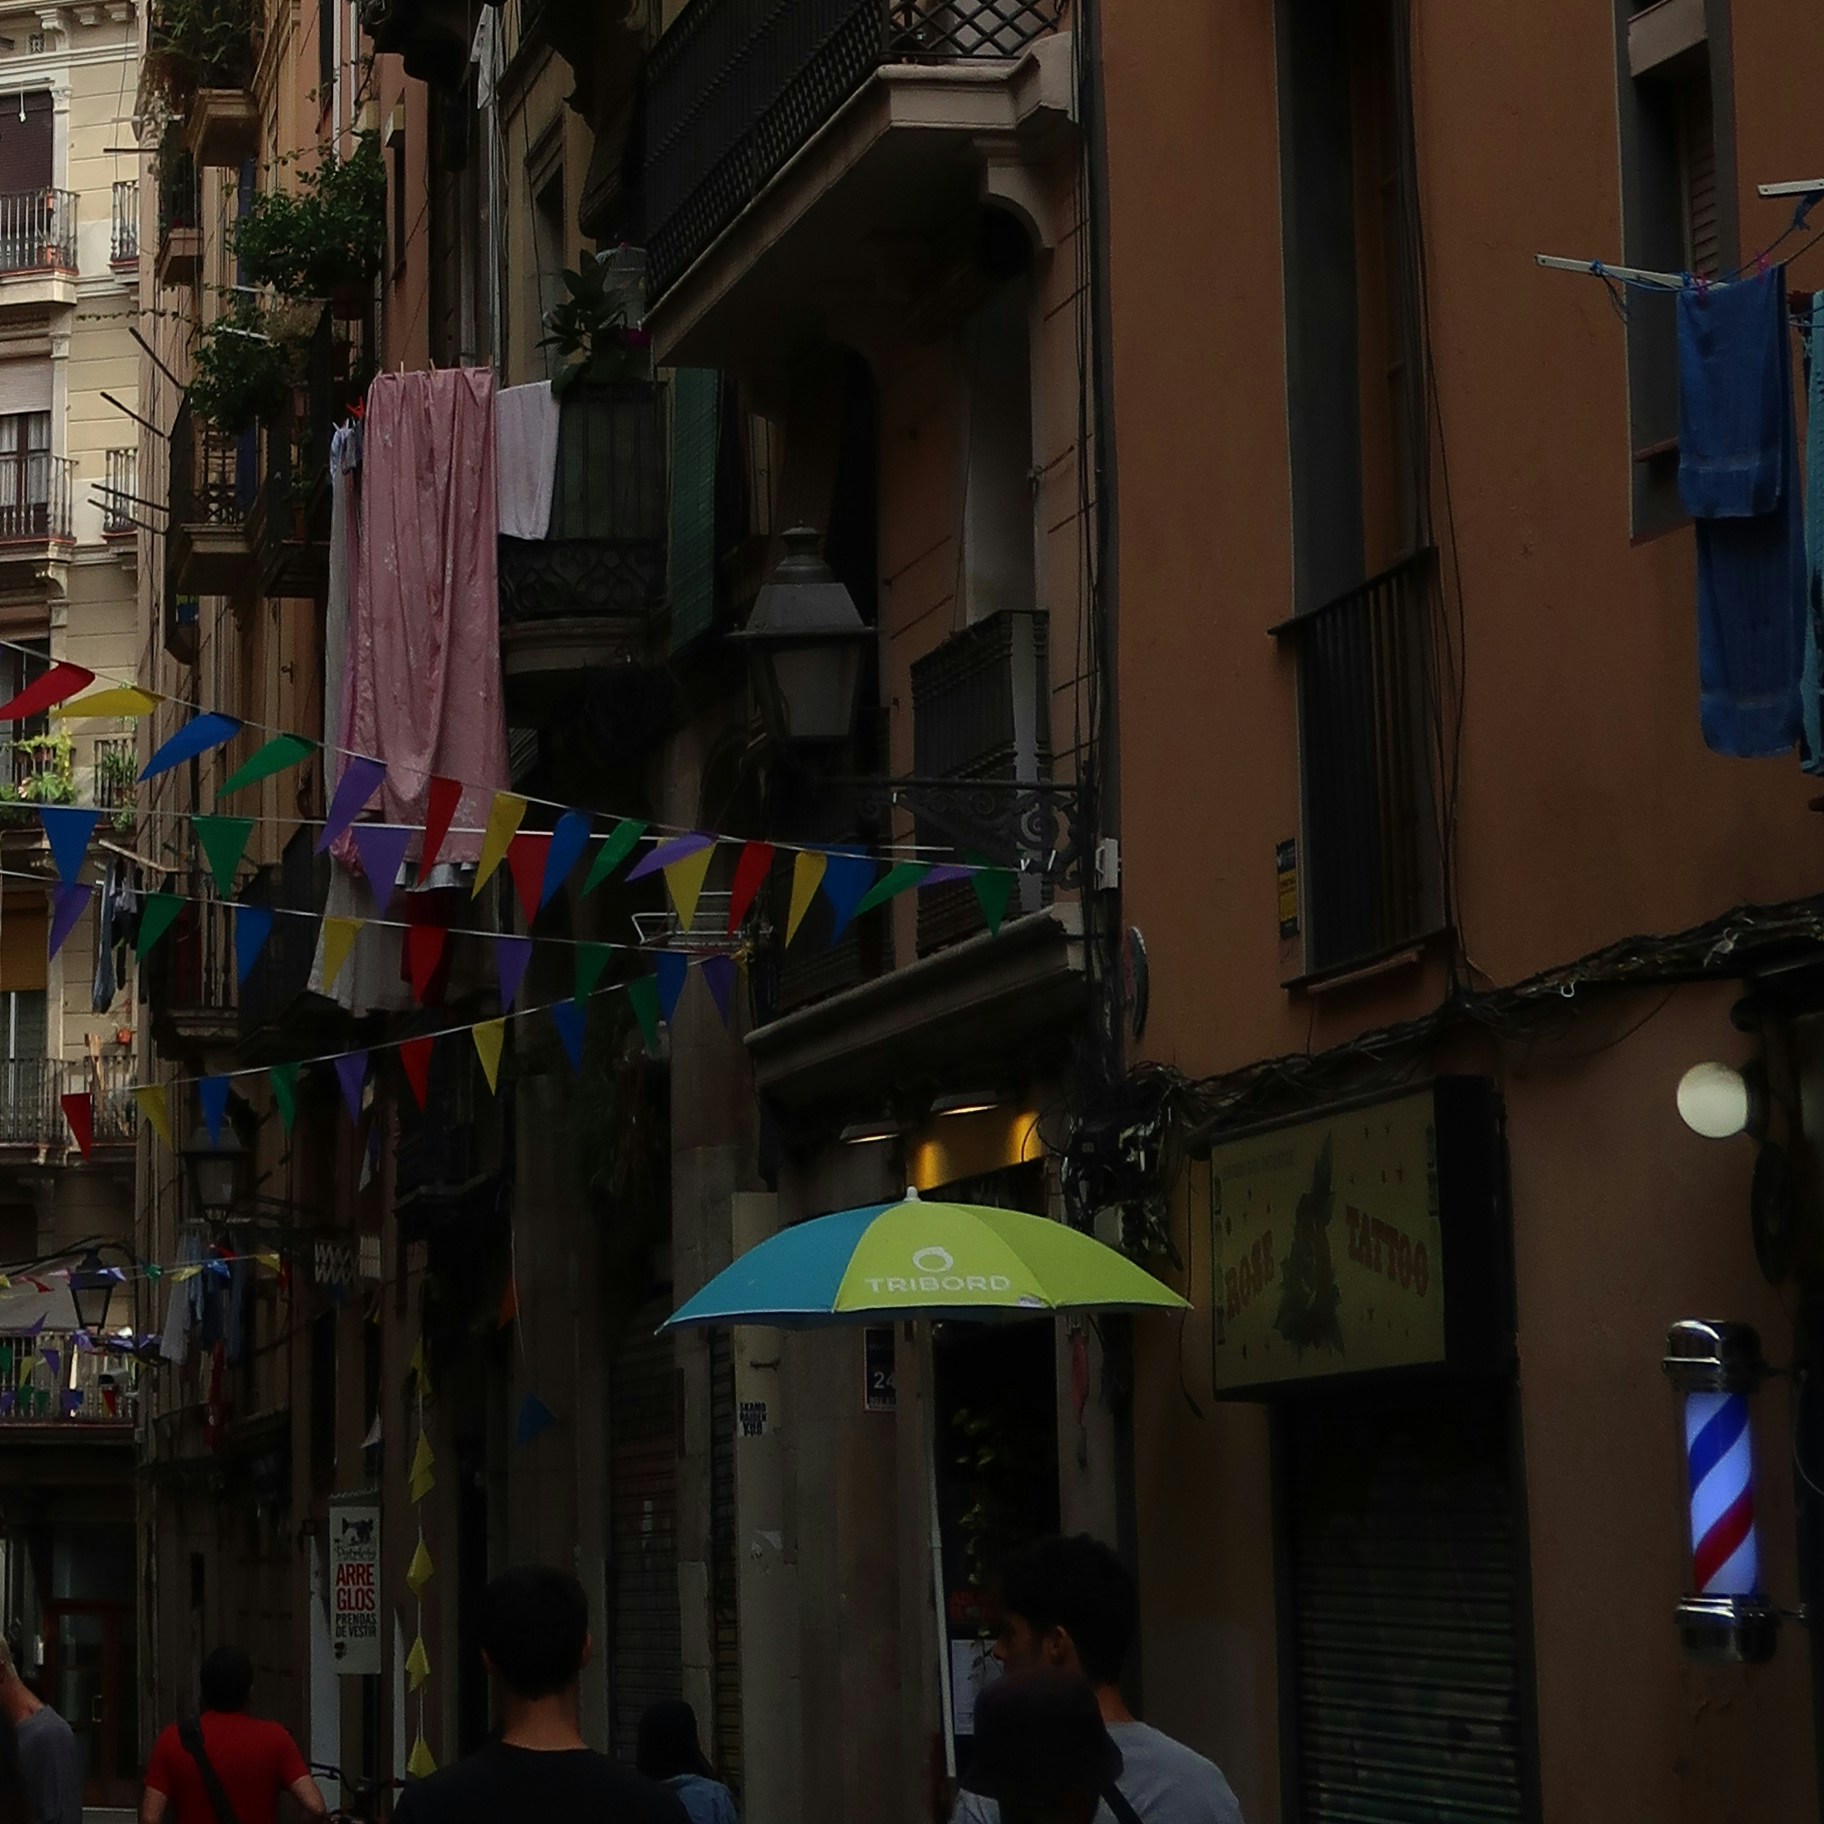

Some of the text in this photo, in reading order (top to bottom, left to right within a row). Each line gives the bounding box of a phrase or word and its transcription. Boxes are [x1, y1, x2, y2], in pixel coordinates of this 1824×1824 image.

[1345, 1204, 1430, 1298] TATTOO
[864, 1275, 1011, 1293] TRIBORD
[336, 1563, 374, 1586] ARRE
[337, 1588, 375, 1611] GLOS
[336, 1613, 376, 1626] PRENDAS
[336, 1626, 376, 1638] DE VESTIR
